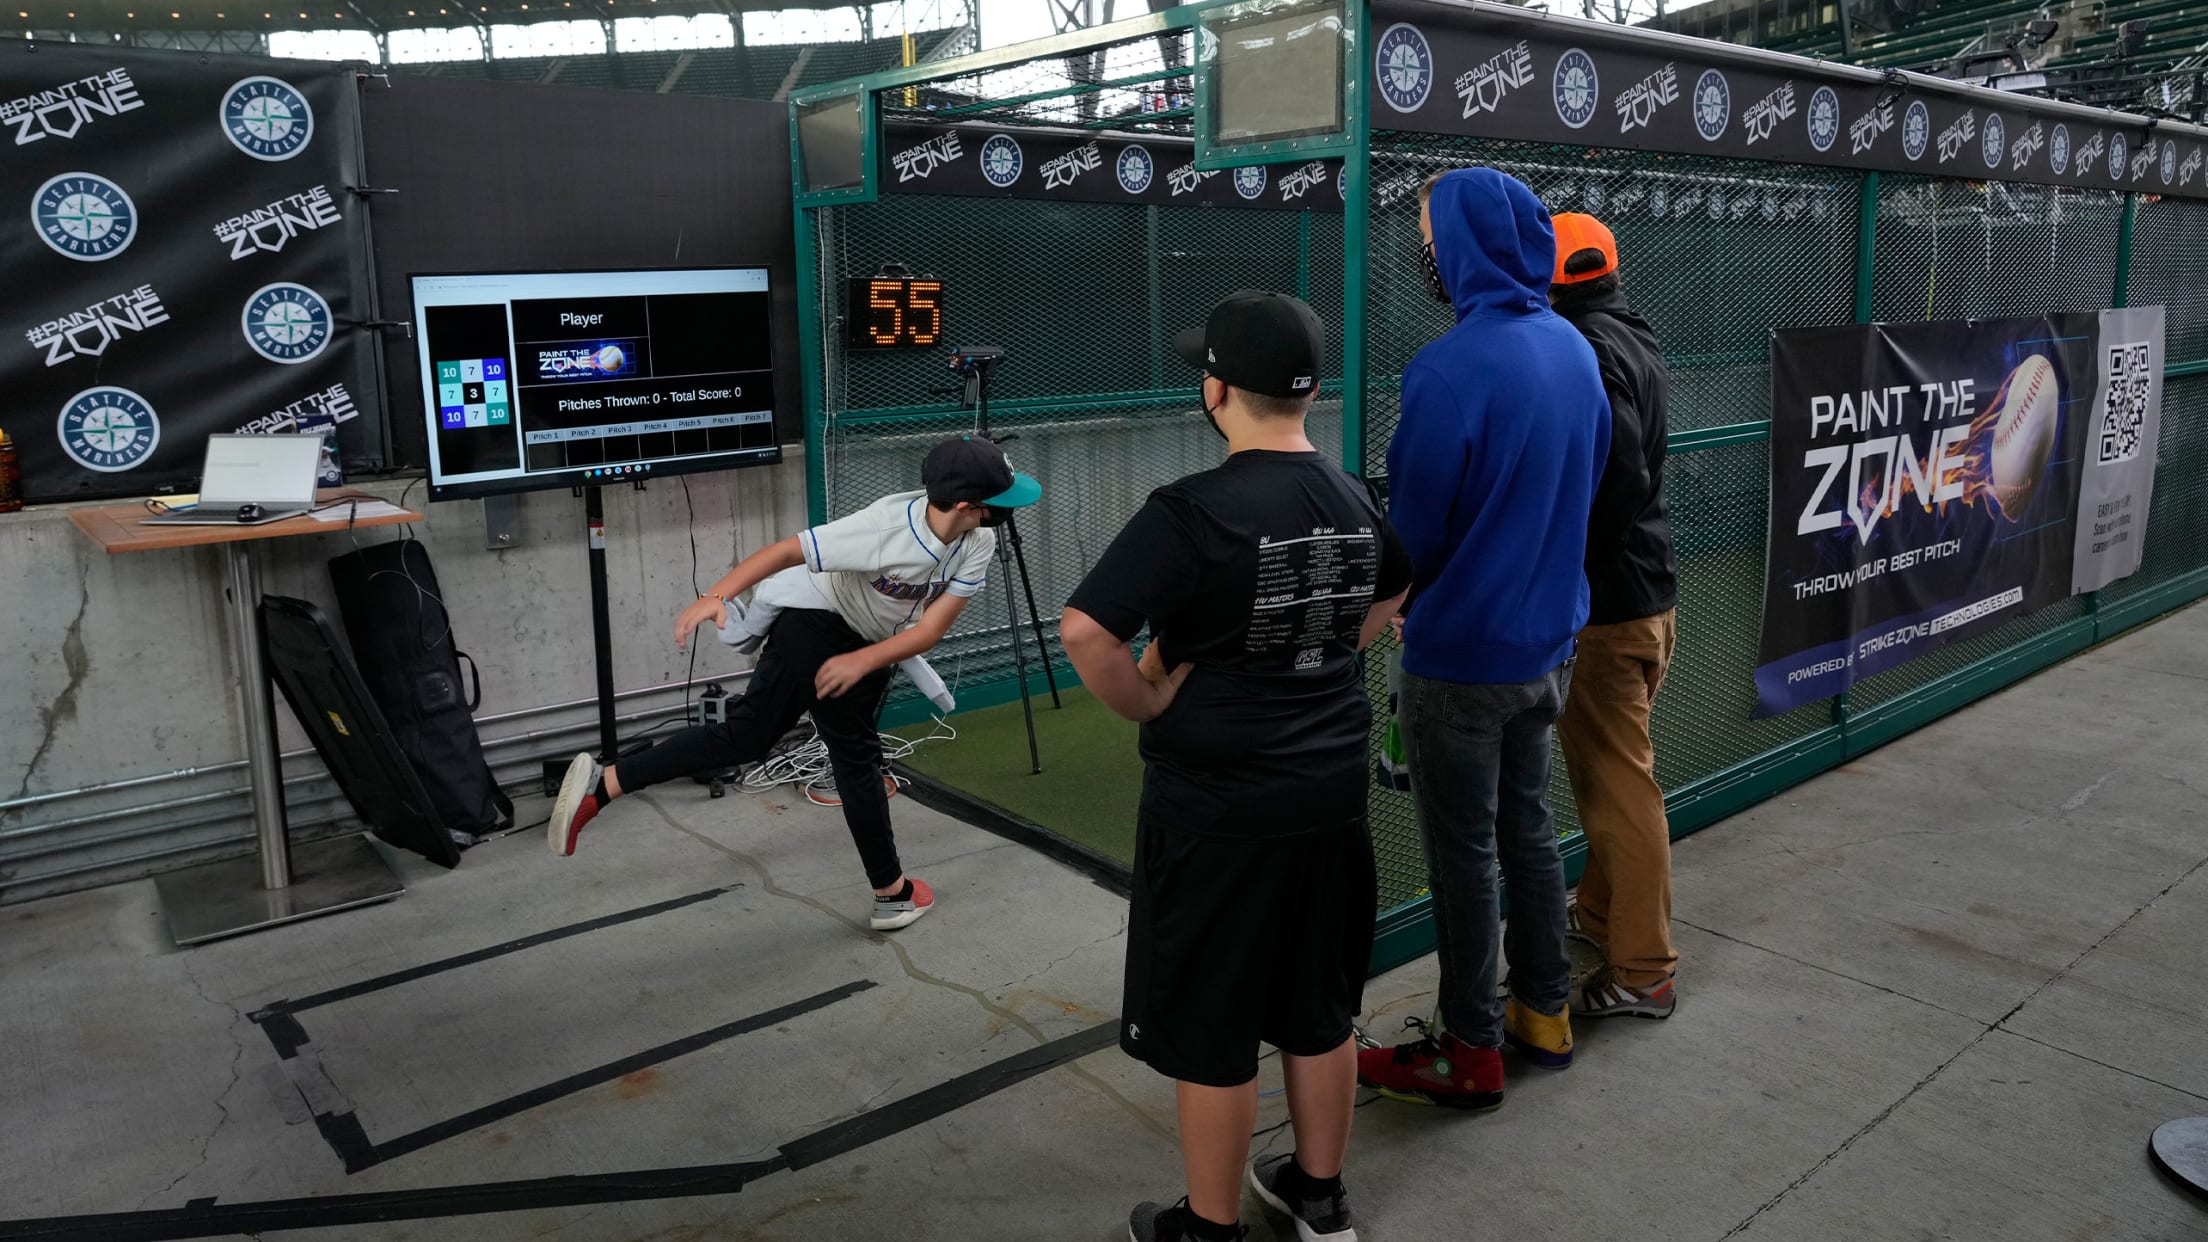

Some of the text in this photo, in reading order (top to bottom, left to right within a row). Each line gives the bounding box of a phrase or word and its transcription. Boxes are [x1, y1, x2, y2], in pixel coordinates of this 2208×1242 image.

[1383, 31, 1427, 60] SEATTLE
[1454, 39, 1529, 92] #PAINT THE
[0, 67, 131, 118] #PAINT THE
[231, 84, 301, 110] SEATTLE
[1382, 74, 1427, 105] MARINERS
[1458, 54, 1535, 120] ZONE
[1614, 61, 1675, 109] #PAINT THE
[3, 80, 145, 146] ZONE
[1617, 74, 1680, 134] ZONE
[1742, 80, 1794, 123] #PAINT THE
[1745, 91, 1796, 146] ZONE
[1851, 106, 1894, 156] ZONE
[232, 126, 305, 152] MARINERS
[892, 129, 958, 166] #PAINT THE
[1938, 116, 1976, 164] ZONE
[2012, 128, 2044, 171] ZONE
[895, 139, 963, 183] ZONE
[1040, 140, 1098, 174] #PAINT THE
[1042, 149, 1102, 190] ZONE
[1166, 160, 1195, 180] #PAIN
[2076, 137, 2104, 177] ZONE
[43, 181, 122, 208] SEATTLE
[1280, 166, 1327, 201] ZONE
[213, 185, 329, 237] #PAINT THE
[47, 224, 127, 253] MARINERS
[221, 197, 342, 261] ZONE
[25, 284, 157, 342] #PAINT THE
[252, 290, 320, 316] SEATTLE
[870, 281, 940, 344] 55
[34, 296, 170, 367] ZONE
[560, 312, 603, 328] Player
[255, 329, 324, 356] MARINERS
[539, 349, 590, 359] PAINT THE
[443, 364, 501, 378] 10 7 10
[539, 356, 591, 373] ZONE
[70, 395, 145, 422] SEATTLE
[304, 383, 349, 408] THE
[448, 387, 499, 400] 7 3 7
[558, 398, 602, 412] Pitches
[604, 395, 650, 408] Thrown:
[652, 393, 660, 404] 0
[670, 390, 696, 403] Total
[698, 388, 732, 401] Score:
[734, 386, 742, 398] 0
[1810, 378, 1975, 439] PAINT THE
[447, 408, 505, 423] 10 7 10
[608, 426, 626, 434] Pitch
[644, 423, 661, 431] Pitch
[678, 420, 696, 428] Pitch
[744, 414, 761, 422] Pitch
[72, 435, 149, 464] MARINERS
[533, 432, 553, 441] Pitch
[1797, 423, 1971, 547] ZONE
[1793, 539, 1961, 600] THROW YOUR BEST PITCH
[1788, 657, 1845, 685] POWERED
